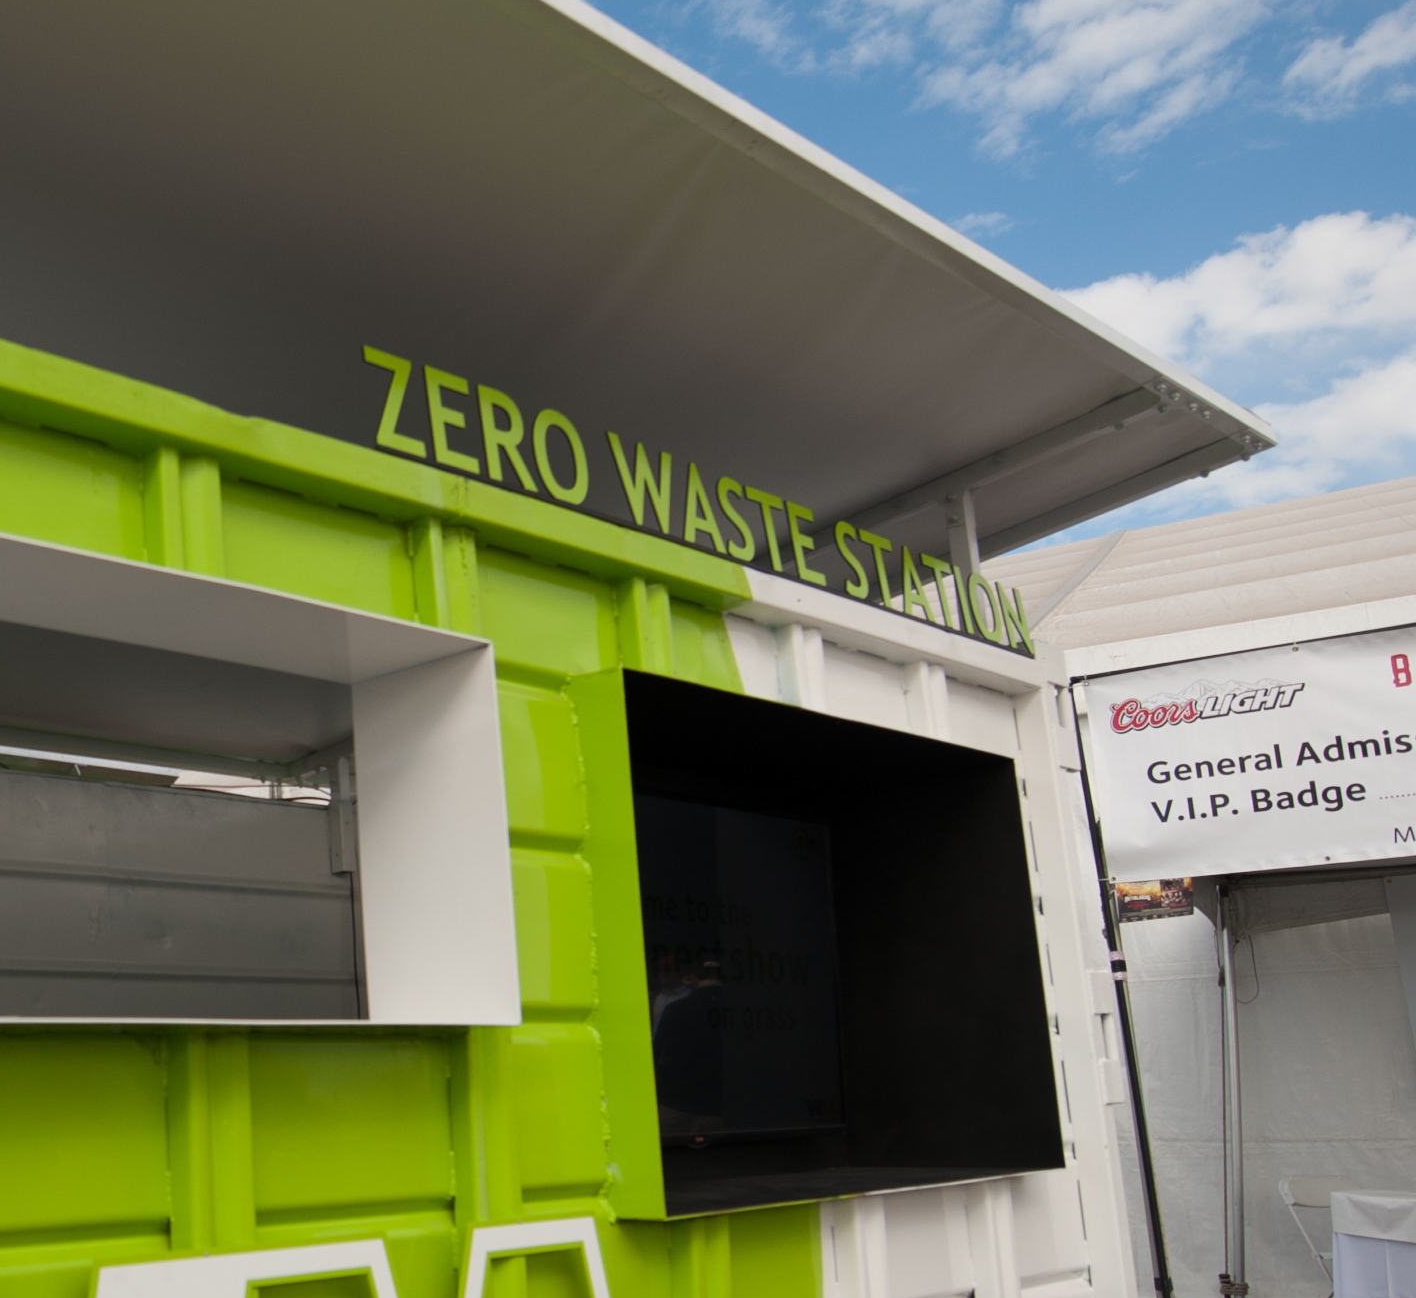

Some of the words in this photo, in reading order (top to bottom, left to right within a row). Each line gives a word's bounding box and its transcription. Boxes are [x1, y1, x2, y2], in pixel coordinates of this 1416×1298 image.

[363, 345, 589, 505] ZERO
[607, 431, 826, 588] WASTE
[834, 521, 1036, 659] STATION
[1110, 698, 1199, 733] Coors
[1198, 682, 1305, 719] LIGHT
[1147, 744, 1283, 784] General
[1151, 794, 1240, 823] V.I.P.
[1250, 780, 1366, 812] Badge
